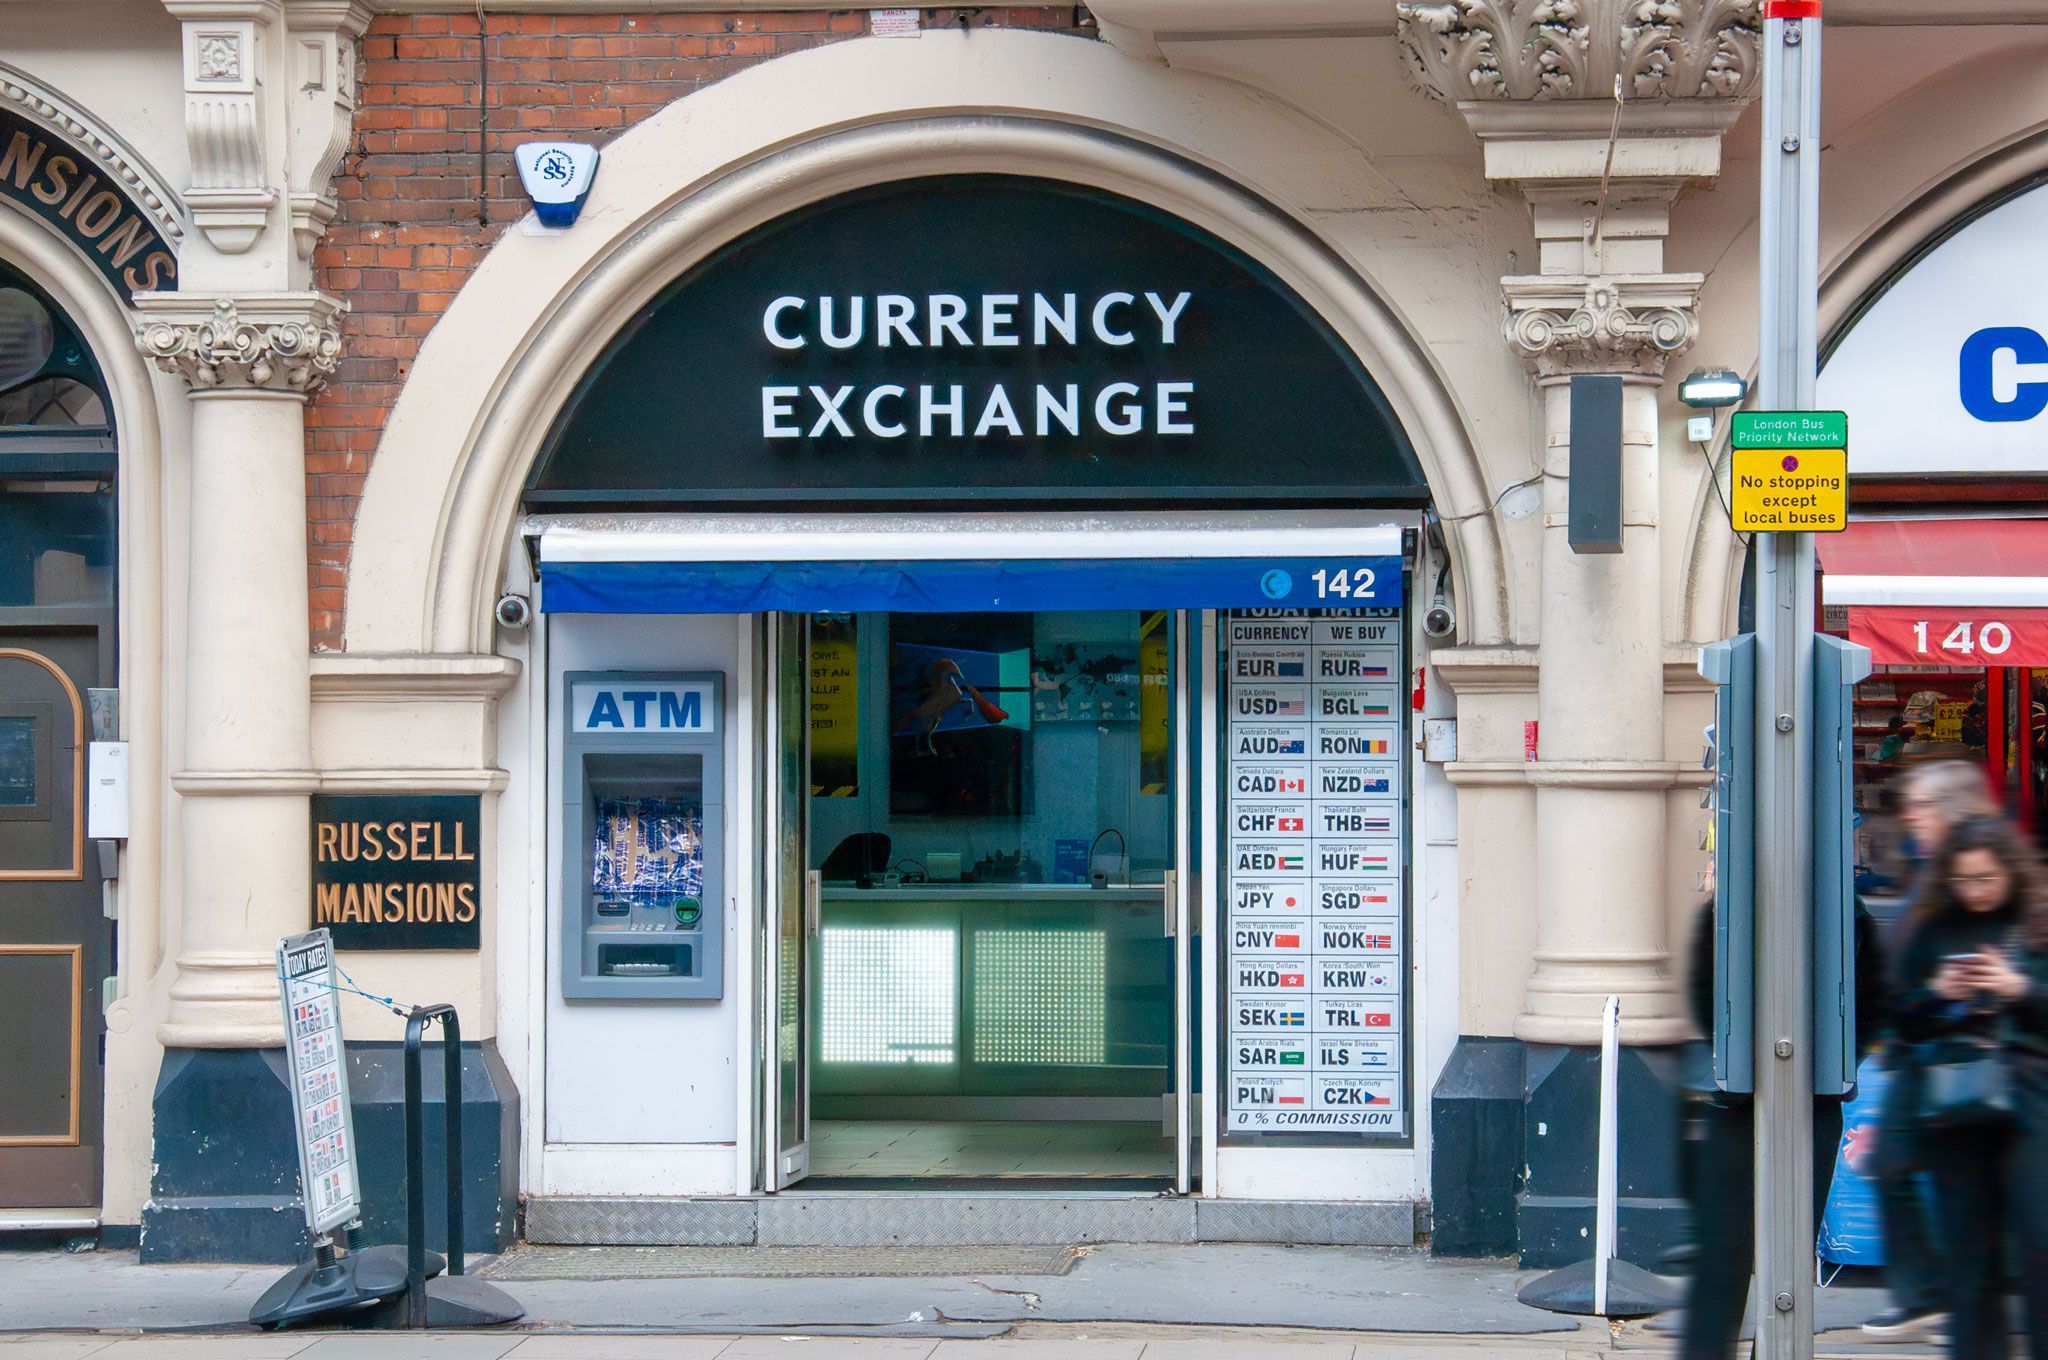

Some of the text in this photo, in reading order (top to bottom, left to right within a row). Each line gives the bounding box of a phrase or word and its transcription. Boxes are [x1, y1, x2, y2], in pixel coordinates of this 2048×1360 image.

[0, 130, 176, 291] NSIONS
[763, 291, 1192, 349] CURRENCY
[762, 382, 1195, 438] EXCHANGE
[1753, 419, 1824, 430] London Bus
[1739, 431, 1839, 443] Priority Network
[1740, 475, 1841, 493] No stopping
[1762, 495, 1818, 509] except
[1744, 511, 1836, 524] local buses
[1312, 568, 1376, 598] 142
[1234, 626, 1308, 640] CURRENCY
[1331, 626, 1386, 639] WE BUY
[1913, 621, 2012, 654] 140
[1237, 660, 1275, 676] EUR
[1321, 660, 1360, 676] RUR
[586, 691, 701, 728] ATM
[1239, 698, 1277, 715] USD
[1322, 698, 1359, 715] BGL
[1239, 737, 1278, 754] AUD
[1321, 737, 1361, 754] RON
[1238, 776, 1276, 792] CAD
[1323, 776, 1361, 792] NZD
[1238, 815, 1275, 831] CHF
[1324, 815, 1362, 831] THB
[318, 821, 475, 862] RUSSELL
[1238, 854, 1275, 870] AED
[1321, 854, 1359, 870] HUF
[317, 882, 476, 923] MANSIONS
[1238, 892, 1274, 908] JPY
[1322, 893, 1360, 909] SGD
[1236, 931, 1274, 947] CNY
[1323, 932, 1365, 948] NOK
[307, 947, 327, 971] RATES
[1240, 971, 1279, 987] HKD
[1323, 971, 1366, 987] KRW
[1239, 1009, 1276, 1025] SEK
[1325, 1010, 1360, 1026] TRL
[1239, 1048, 1276, 1064] SAR
[1321, 1049, 1349, 1065] ILS
[1238, 1087, 1274, 1103] PLN
[1324, 1087, 1362, 1104] CZK
[1238, 1112, 1393, 1124] 0 % COMMISSION
